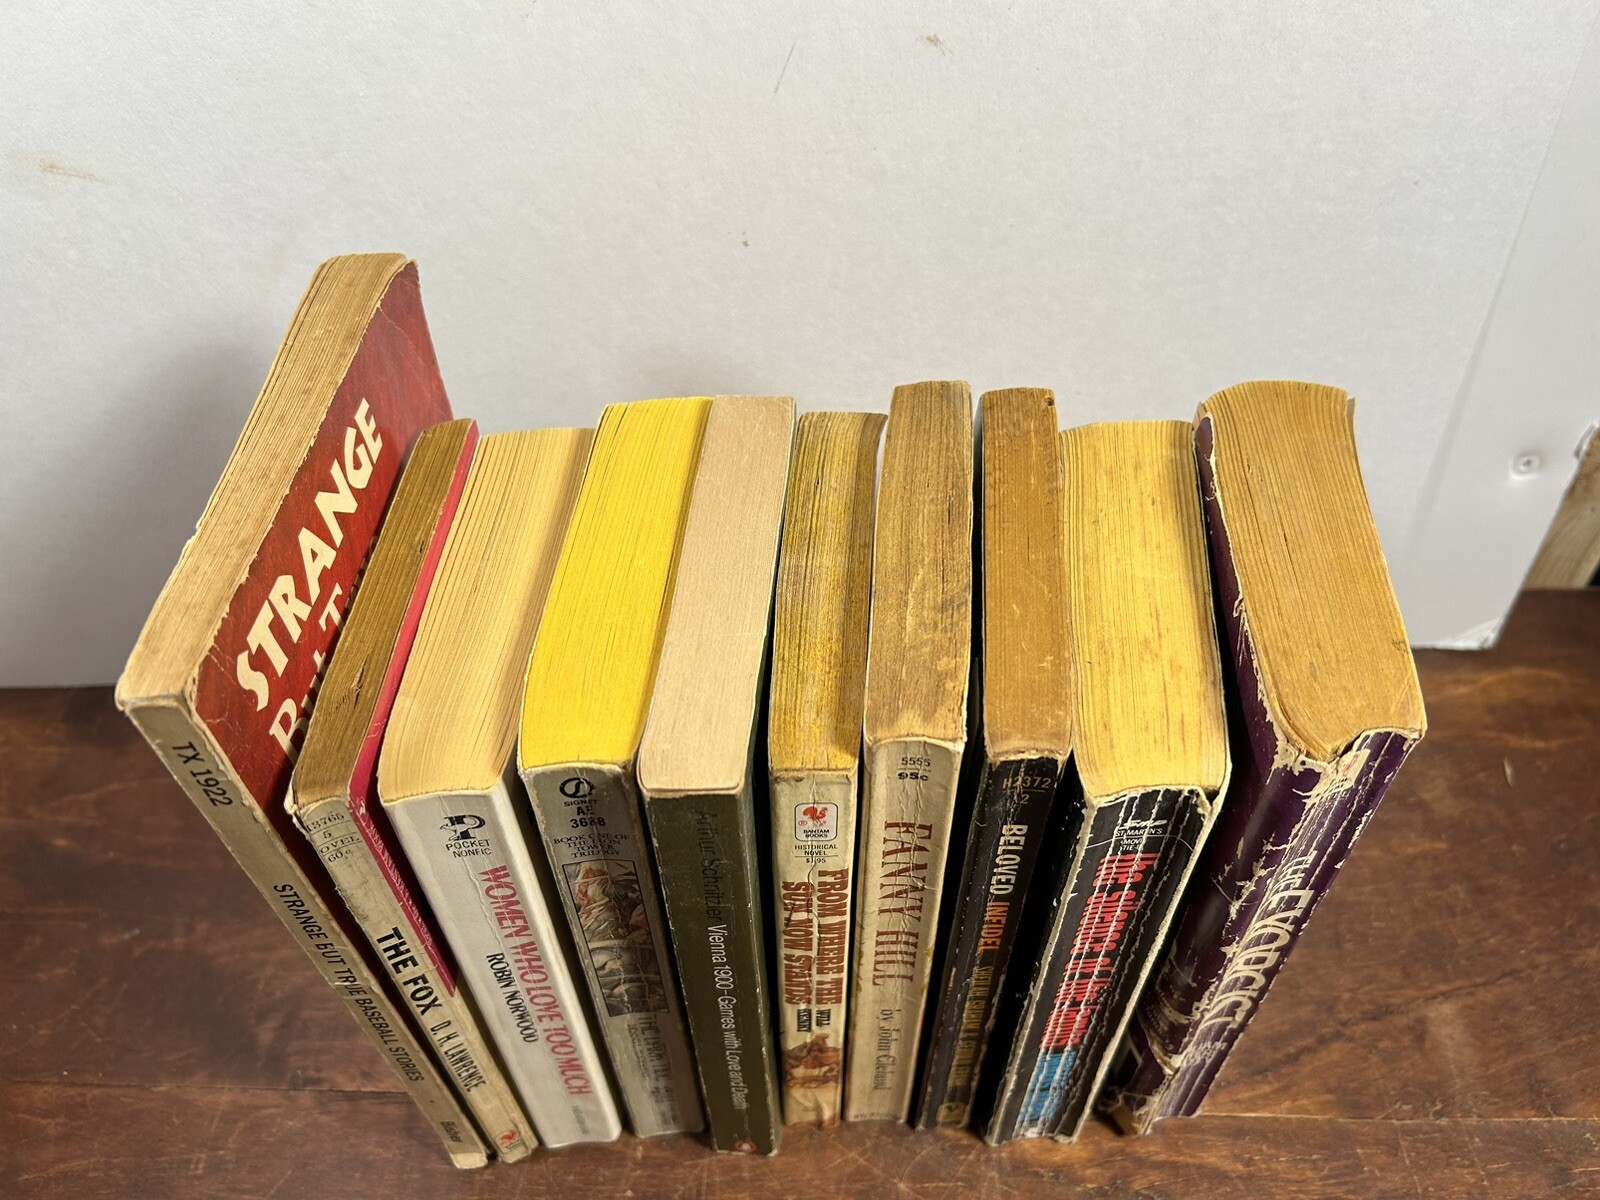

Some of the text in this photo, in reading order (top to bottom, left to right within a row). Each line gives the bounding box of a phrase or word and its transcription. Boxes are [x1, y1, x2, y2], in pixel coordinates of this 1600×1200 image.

[236, 397, 383, 712] STRANGE
[172, 741, 233, 807] TX 1922
[901, 756, 931, 767] 5555
[1002, 775, 1052, 789] H2372
[564, 799, 598, 807] SIGNET
[320, 836, 360, 853] OVEL
[445, 838, 491, 852] POCKET
[553, 834, 586, 844] BOOK
[567, 840, 589, 848] THE
[694, 809, 719, 855] Arthur
[1127, 828, 1163, 836] MARN'S
[453, 848, 492, 858] NONFIC
[1092, 852, 1161, 887] the
[479, 865, 533, 939] WOMEN
[701, 858, 726, 921] Schnitzler
[872, 821, 933, 986] FANNY HILL
[977, 824, 1029, 954] BELOVED INFIDEL
[815, 868, 849, 1005] FROM WHERE THE
[1070, 890, 1140, 955] silence
[510, 940, 549, 985] WHO
[707, 924, 728, 963] Vienna
[782, 881, 814, 1005] SUN NOW STANDS
[1199, 889, 1315, 1029] EXORCIST
[273, 883, 425, 1082] STRANGE BUT TRUE BASEBALL STORIES
[1063, 957, 1117, 976] of
[376, 926, 418, 974] THE
[402, 974, 443, 1016] FOX
[444, 1045, 488, 1093] LAWRENCE
[486, 952, 539, 1043] ROBIN NORWOOD
[526, 985, 564, 1023] LOVE
[815, 1008, 831, 1027] WILL
[543, 1025, 578, 1056] TOO
[723, 1031, 742, 1049] with
[555, 1056, 593, 1096] MUCH
[725, 1050, 743, 1071] Love
